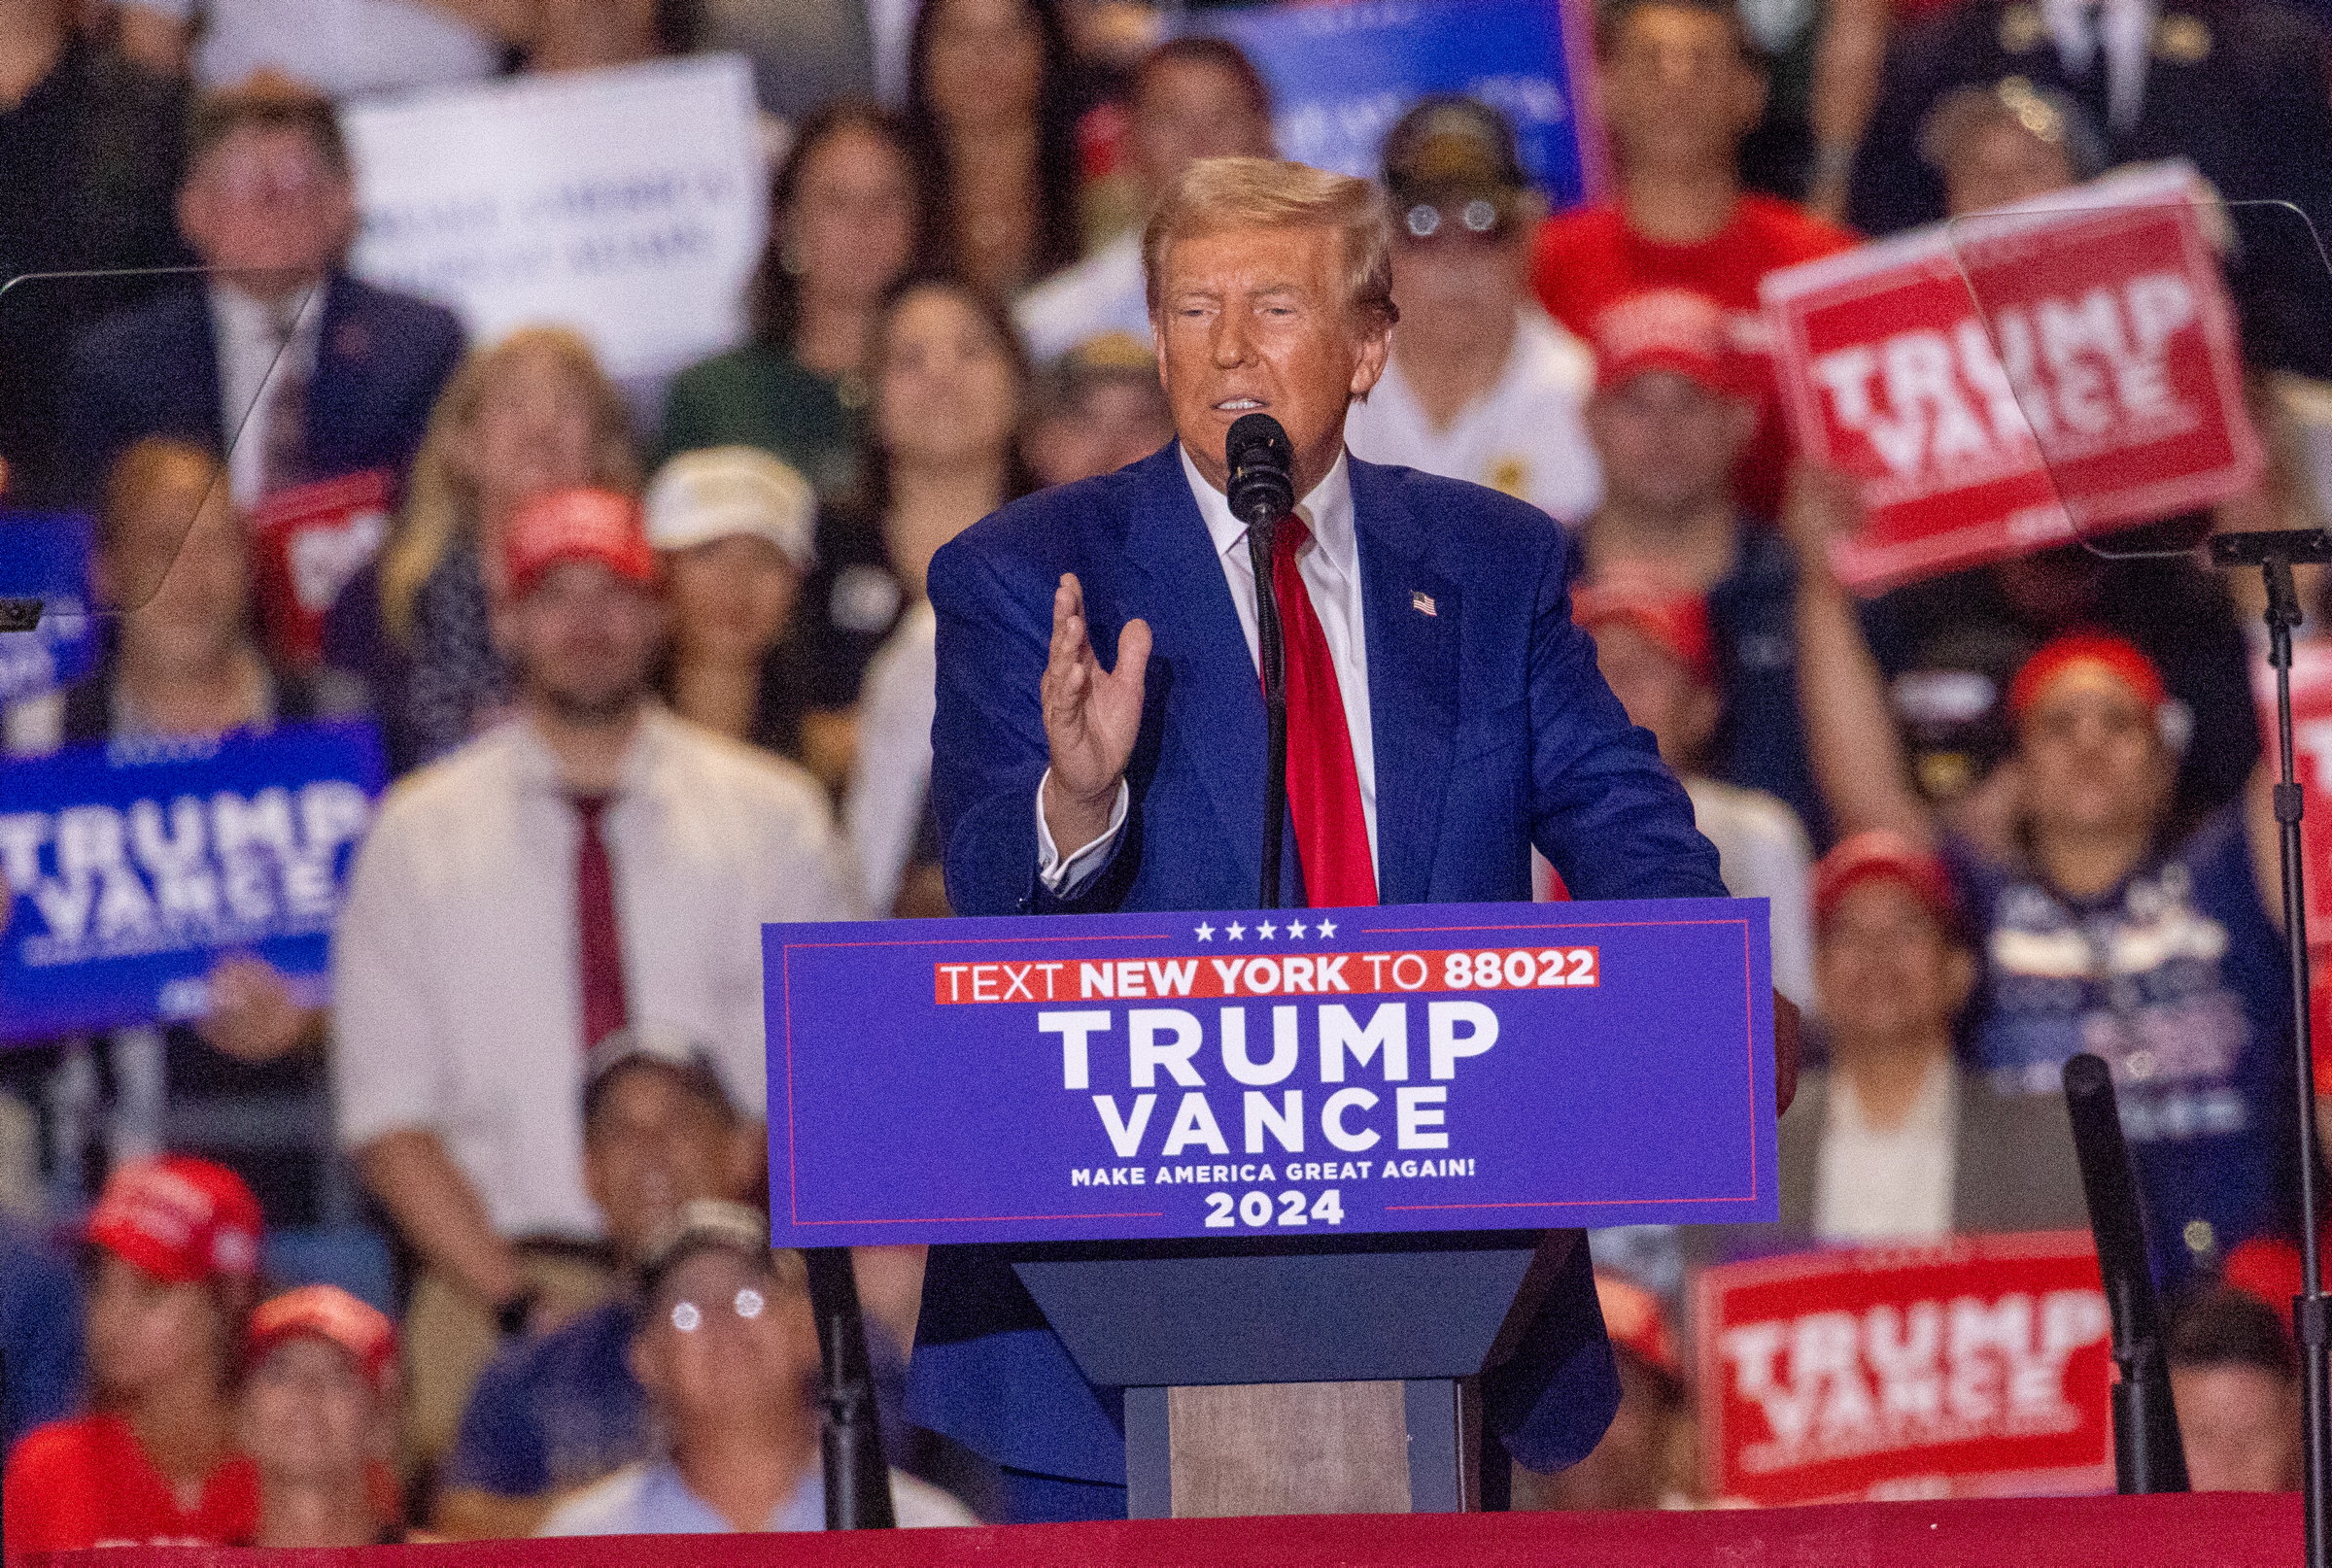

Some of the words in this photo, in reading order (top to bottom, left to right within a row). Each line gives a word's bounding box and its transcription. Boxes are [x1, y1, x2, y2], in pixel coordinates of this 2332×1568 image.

[1815, 276, 2194, 431] TRUMP
[1868, 352, 2178, 476] VANCE
[0, 780, 369, 888] TRUMP
[37, 855, 334, 942] VANCE
[940, 963, 1064, 1002] TEXT
[1079, 959, 1199, 998] NEW
[1211, 955, 1351, 995] YORK
[1361, 952, 1429, 991] TO
[1443, 948, 1595, 989] 88022
[1037, 1000, 1500, 1091] TRUMP
[1091, 1085, 1450, 1159] VANCE
[1070, 1167, 1147, 1187] MAKE
[1154, 1163, 1277, 1185] AMERICA
[1285, 1161, 1373, 1181] GREAT
[1381, 1157, 1476, 1179] AGAIN!
[1204, 1188, 1346, 1229] 2024
[1720, 1290, 2109, 1391] TRUMP
[1755, 1356, 2070, 1444] VANCE
